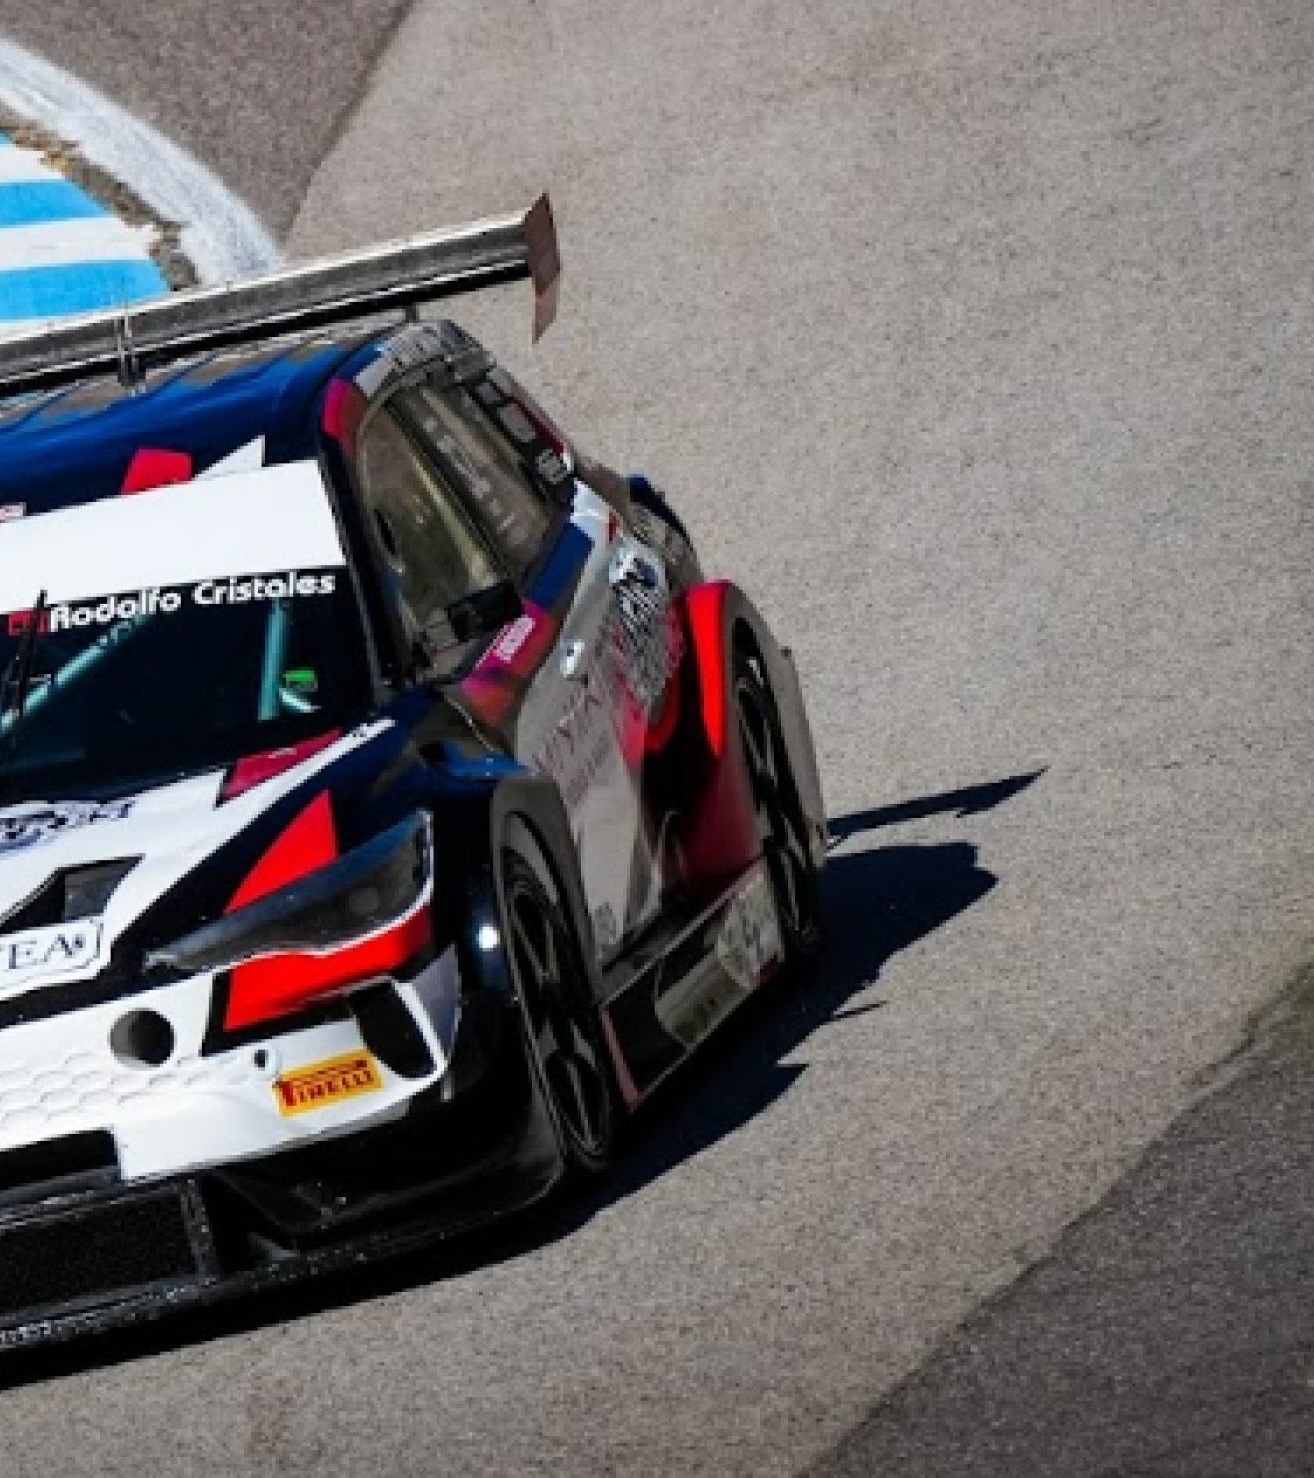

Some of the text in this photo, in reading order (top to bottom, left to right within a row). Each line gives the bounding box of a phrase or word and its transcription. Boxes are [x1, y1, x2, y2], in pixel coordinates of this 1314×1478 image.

[49, 570, 336, 633] Rodolfo Cristales
[279, 1057, 376, 1108] PIRELLI
